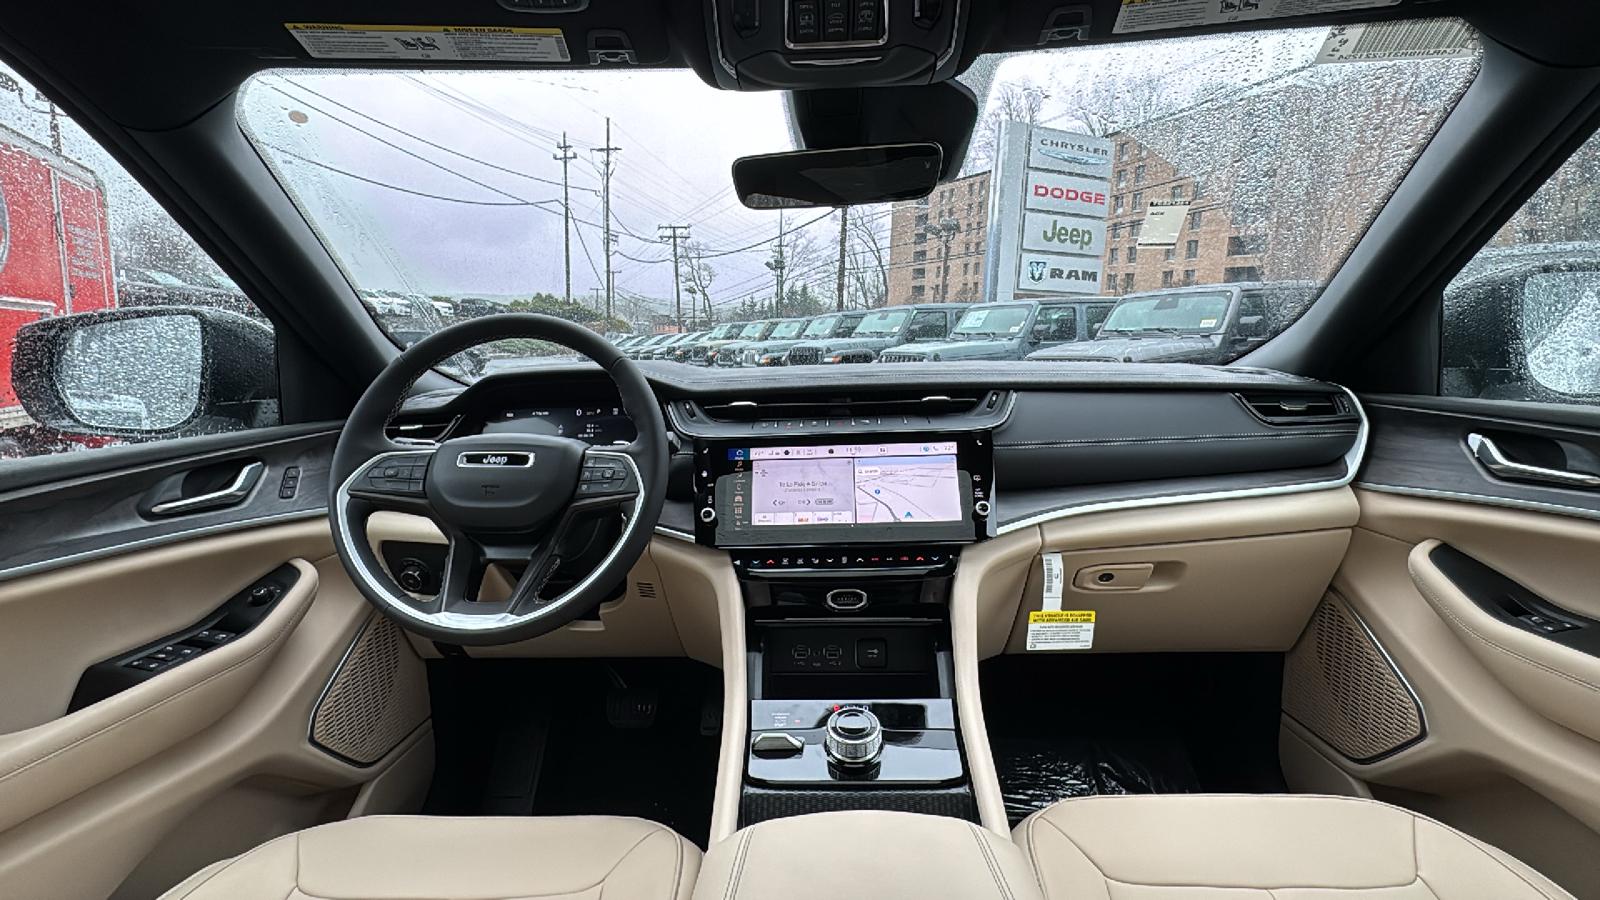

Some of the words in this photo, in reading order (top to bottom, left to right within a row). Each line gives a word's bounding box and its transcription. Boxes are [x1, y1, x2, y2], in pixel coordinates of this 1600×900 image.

[1040, 137, 1109, 157] CHRYSLER
[1033, 184, 1106, 206] DODGE
[1042, 219, 1093, 251] Jeep
[1049, 266, 1098, 283] RAM
[482, 454, 508, 466] Jeep
[833, 704, 840, 712] P
